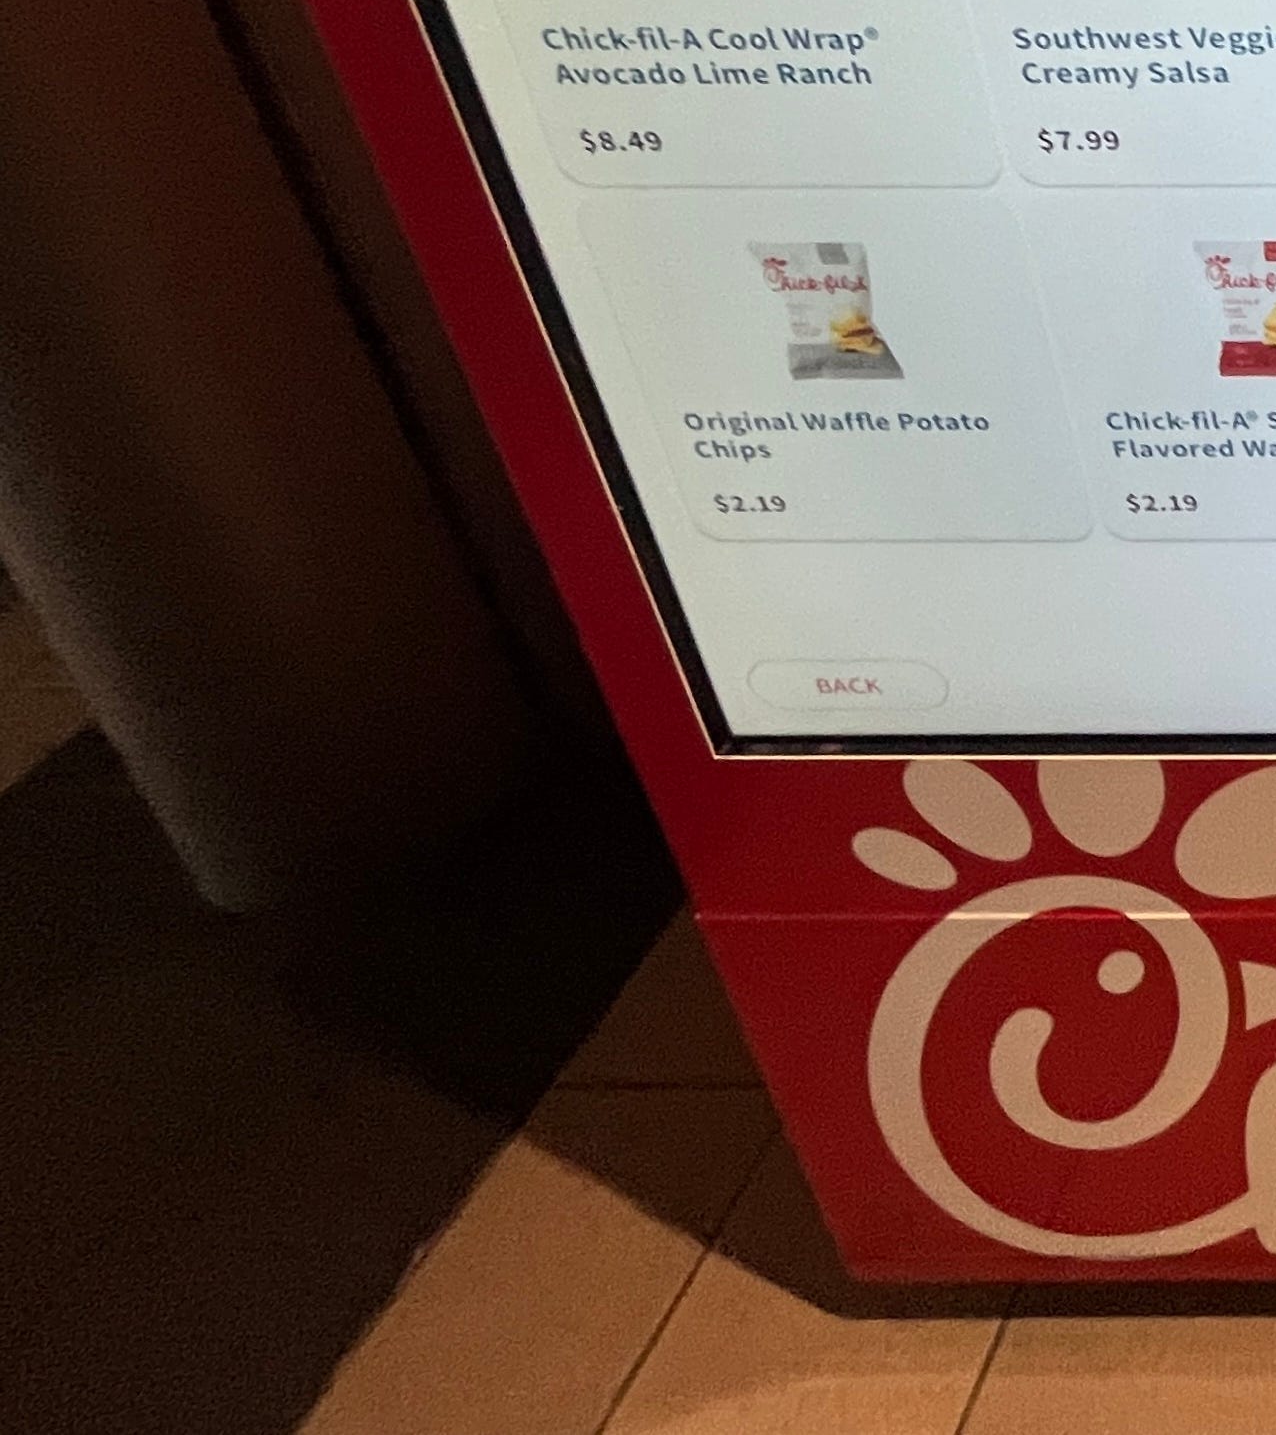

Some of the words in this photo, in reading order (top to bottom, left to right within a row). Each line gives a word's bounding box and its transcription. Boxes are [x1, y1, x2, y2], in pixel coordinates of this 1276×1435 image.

[542, 27, 702, 52] Chick-fil-A
[708, 27, 780, 51] Cool
[1013, 27, 1183, 51] Southwest
[557, 61, 686, 86] Avocado
[693, 62, 770, 86] Lime
[777, 62, 873, 86] Ranch
[1022, 63, 1140, 91] Creamy
[1148, 61, 1231, 85] Salsa
[580, 129, 664, 156] $8.49
[1038, 129, 1121, 156] $7.99
[684, 412, 799, 437] Original
[800, 412, 891, 432] Waffle
[898, 413, 991, 432] Potato
[694, 439, 773, 464] Chips
[1113, 438, 1236, 460] Flavored
[714, 492, 788, 515] $2.19
[1126, 492, 1199, 515] $2.19
[816, 677, 884, 697] BACK
